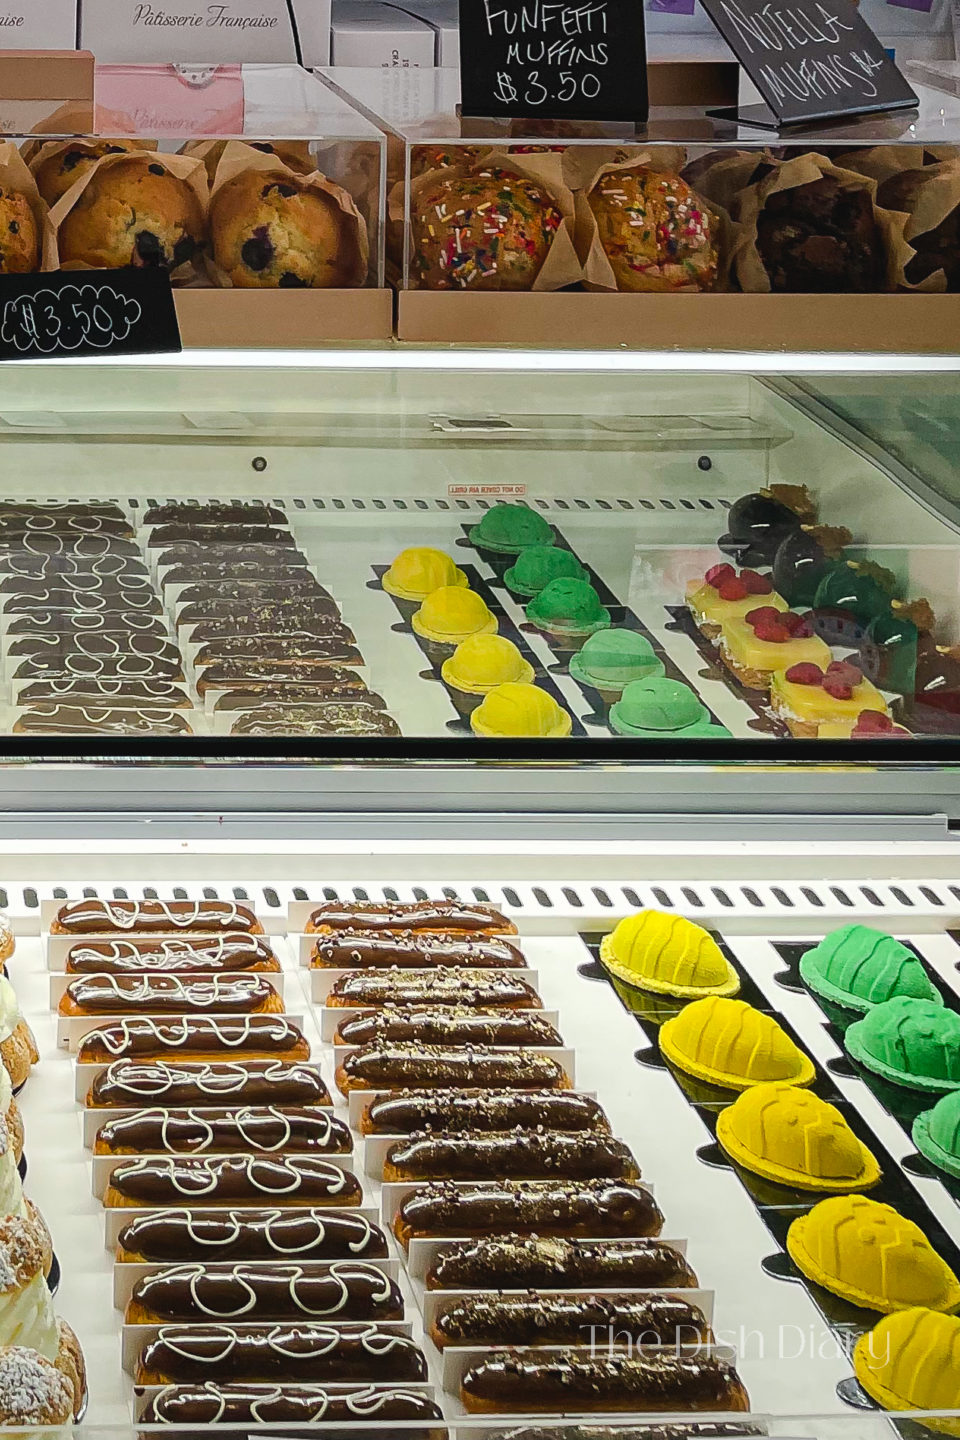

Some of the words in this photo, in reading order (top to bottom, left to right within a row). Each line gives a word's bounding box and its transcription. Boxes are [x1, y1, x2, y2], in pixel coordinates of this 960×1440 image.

[133, 4, 204, 26] Pâtisserie
[207, 5, 279, 30] Française
[507, 39, 608, 66] MUFFINS
[19, 303, 113, 338] $3.50
